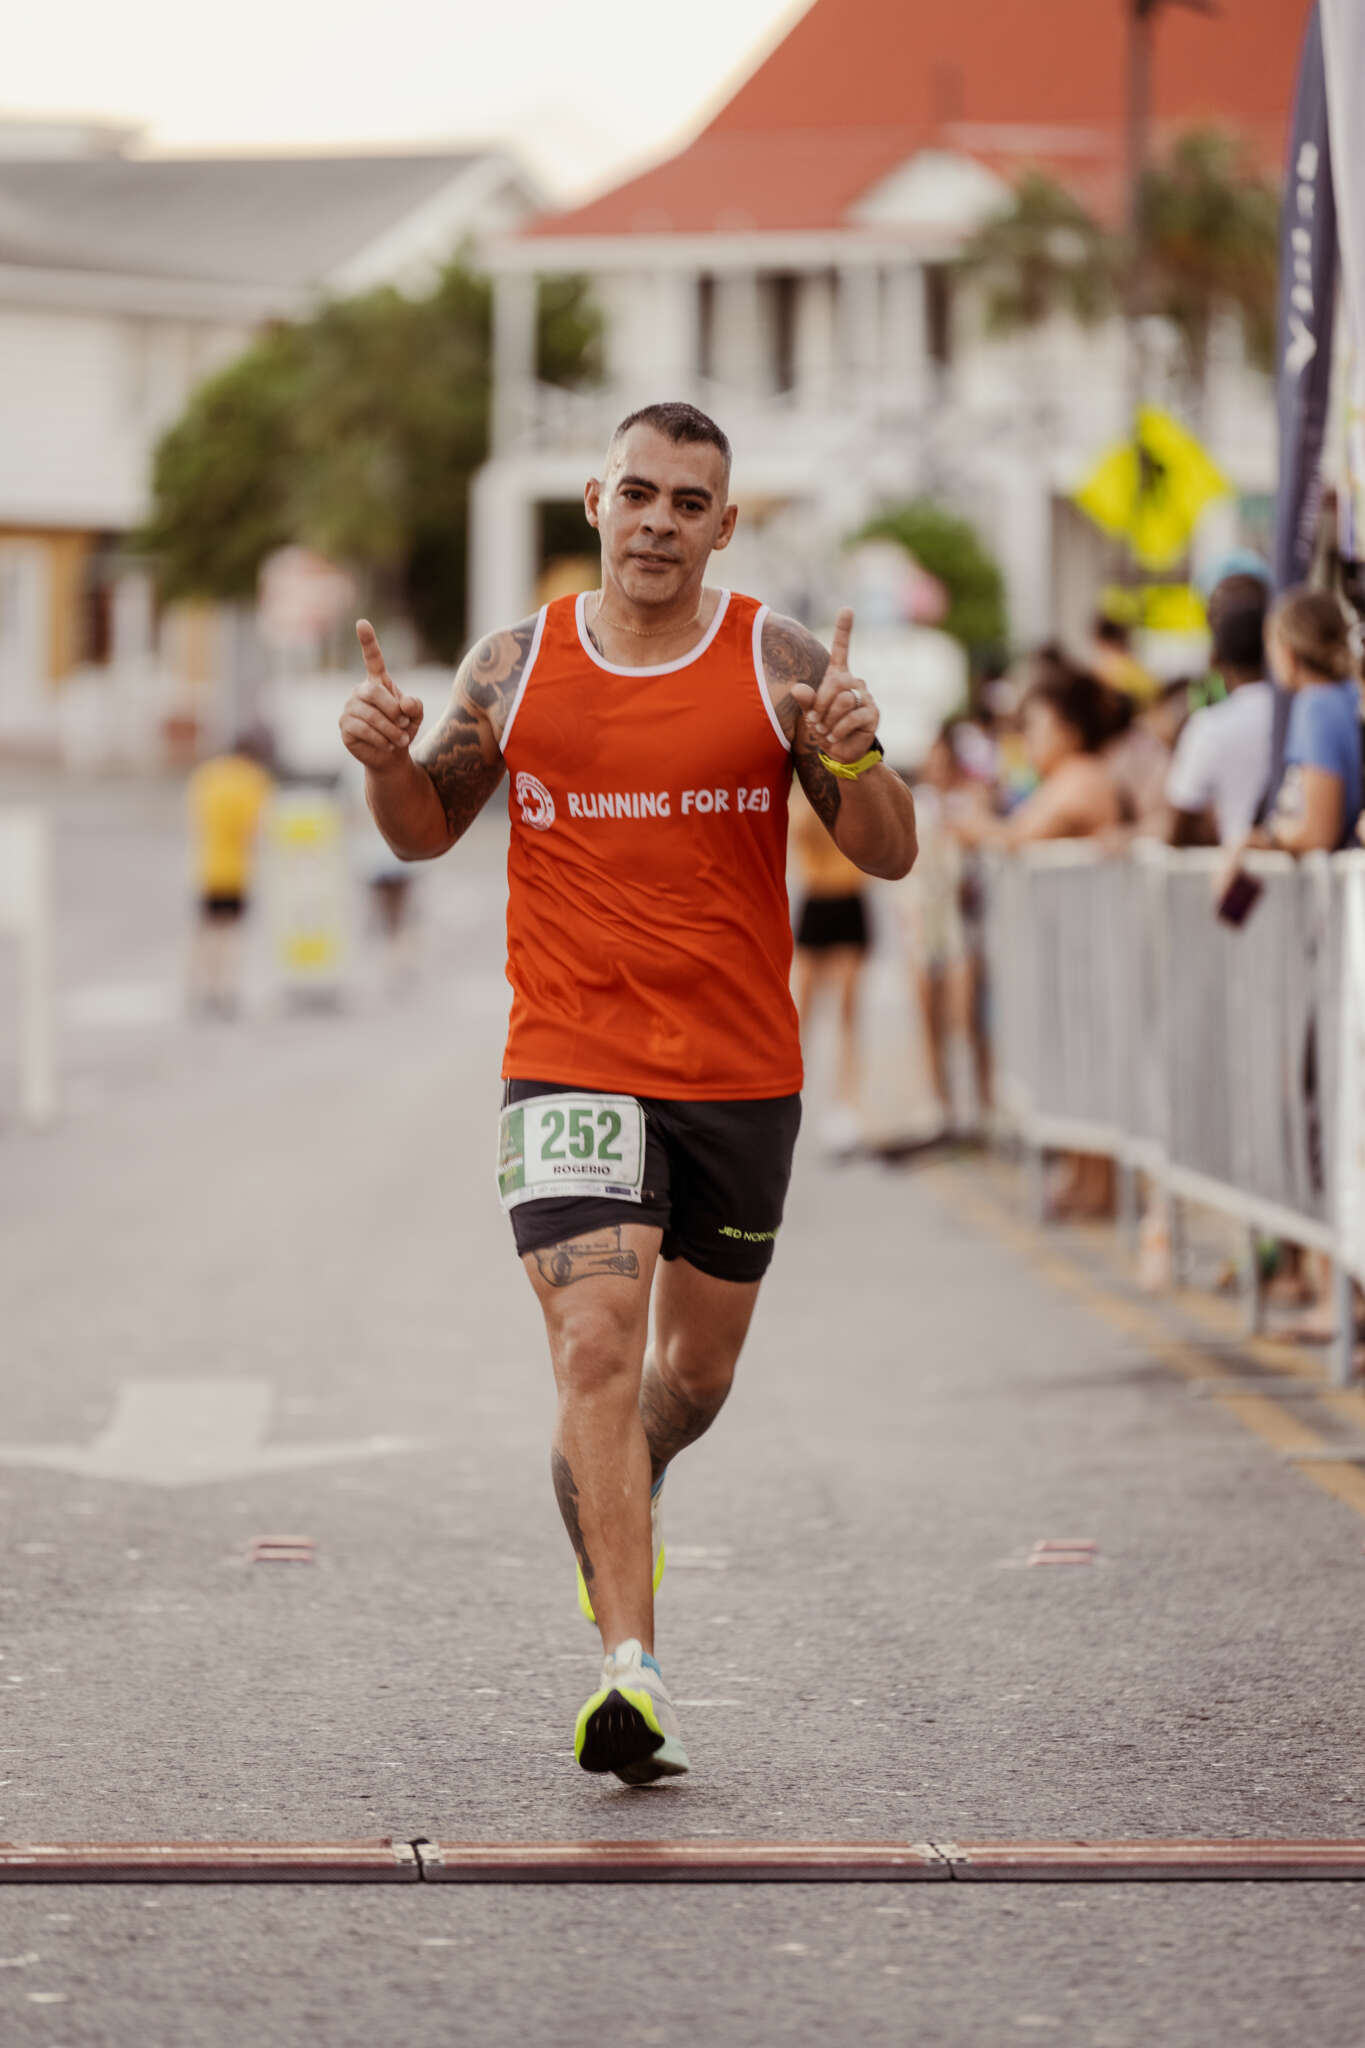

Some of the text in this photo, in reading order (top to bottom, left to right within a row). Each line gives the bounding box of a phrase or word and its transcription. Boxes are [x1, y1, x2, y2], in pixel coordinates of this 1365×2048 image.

[567, 792, 671, 819] RUNNING
[681, 789, 729, 815] FOR
[737, 787, 770, 813] RED
[541, 1109, 622, 1161] 252
[553, 1165, 611, 1176] ROGERIO
[718, 1225, 742, 1239] JED
